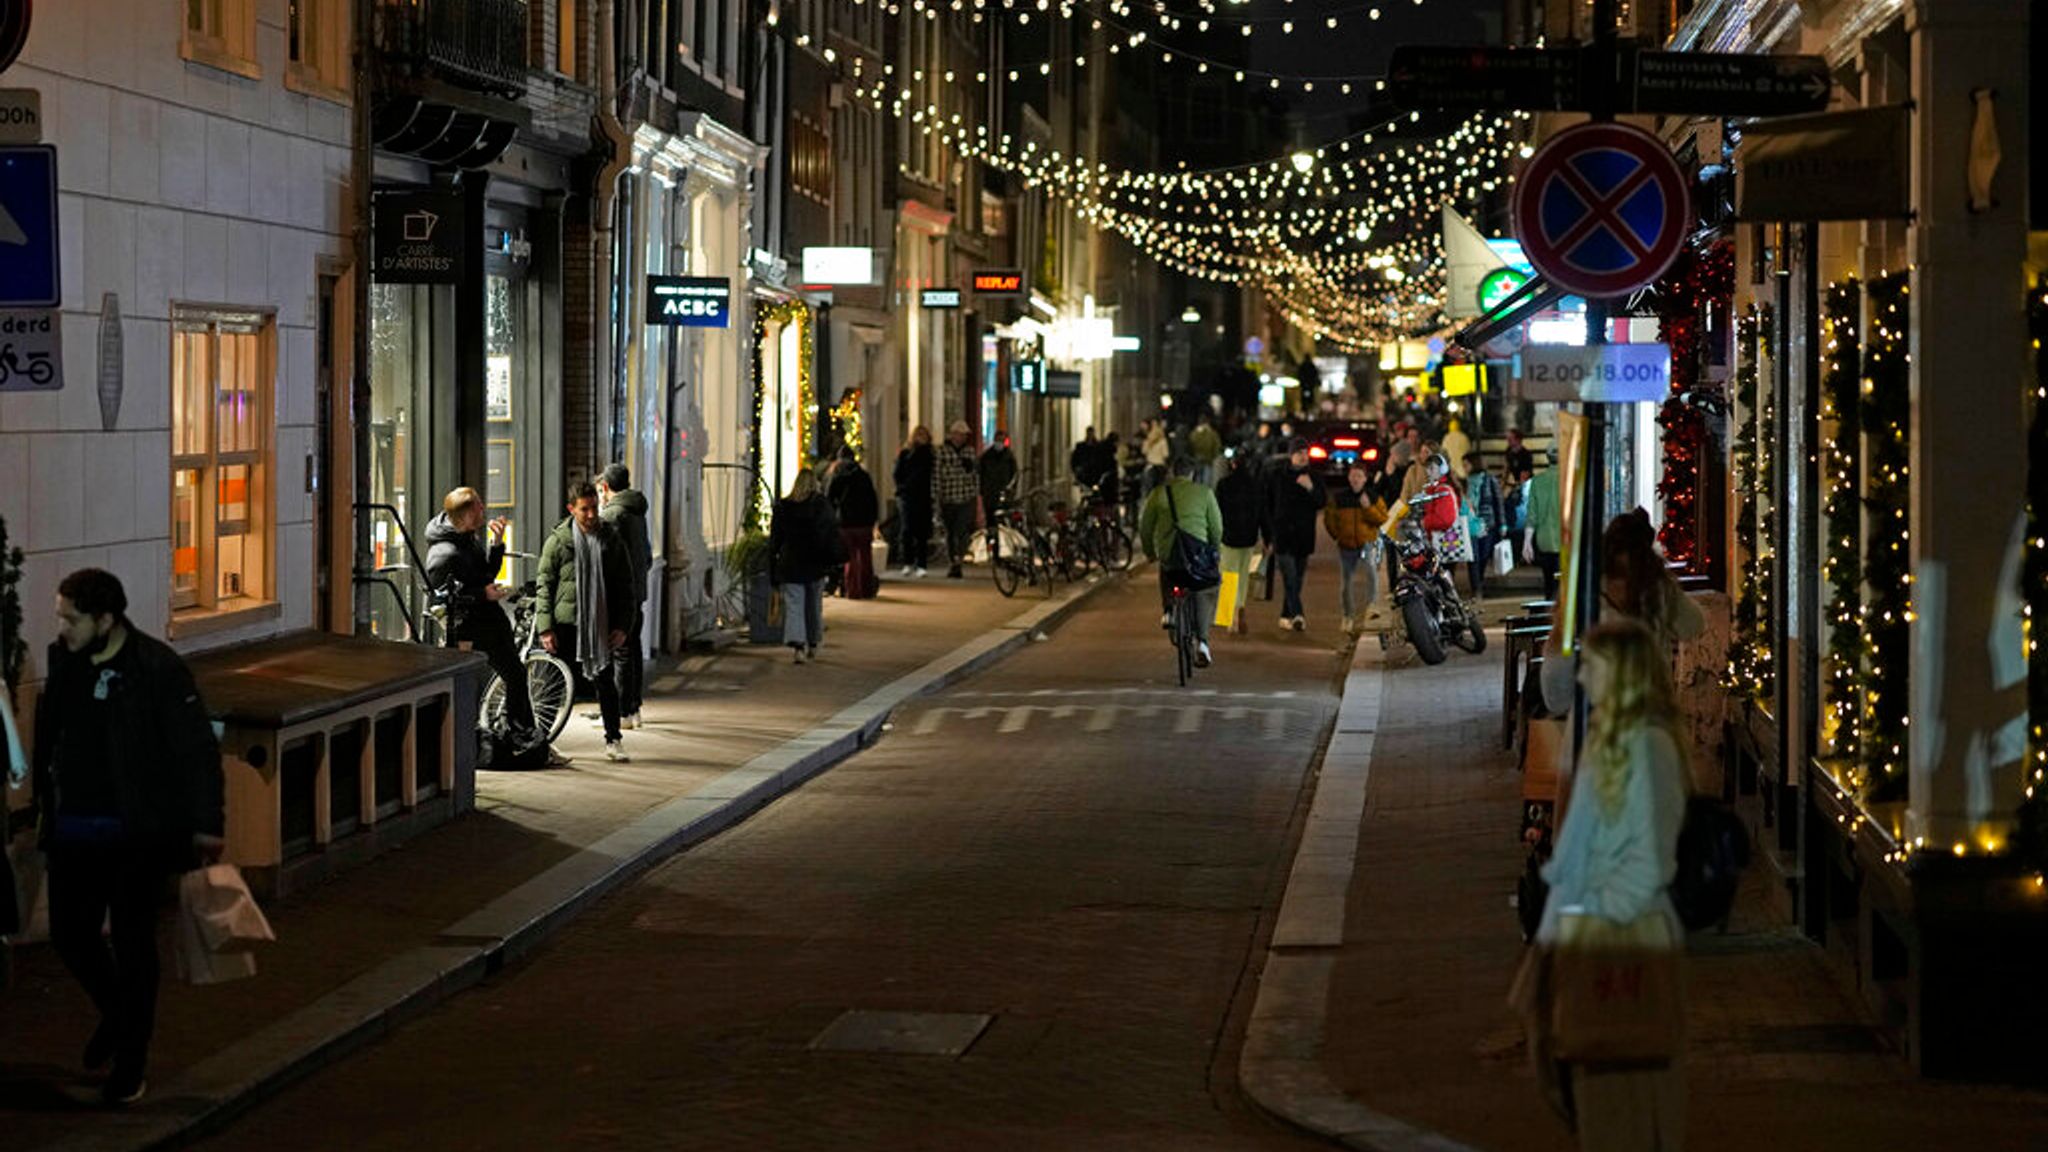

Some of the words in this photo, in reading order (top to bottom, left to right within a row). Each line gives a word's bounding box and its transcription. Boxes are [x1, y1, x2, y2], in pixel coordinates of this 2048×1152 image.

[975, 277, 1020, 289] REPLAY
[663, 299, 719, 316] ACBC
[2, 316, 50, 334] derd
[1528, 364, 1664, 382] 12.00-18.00h
